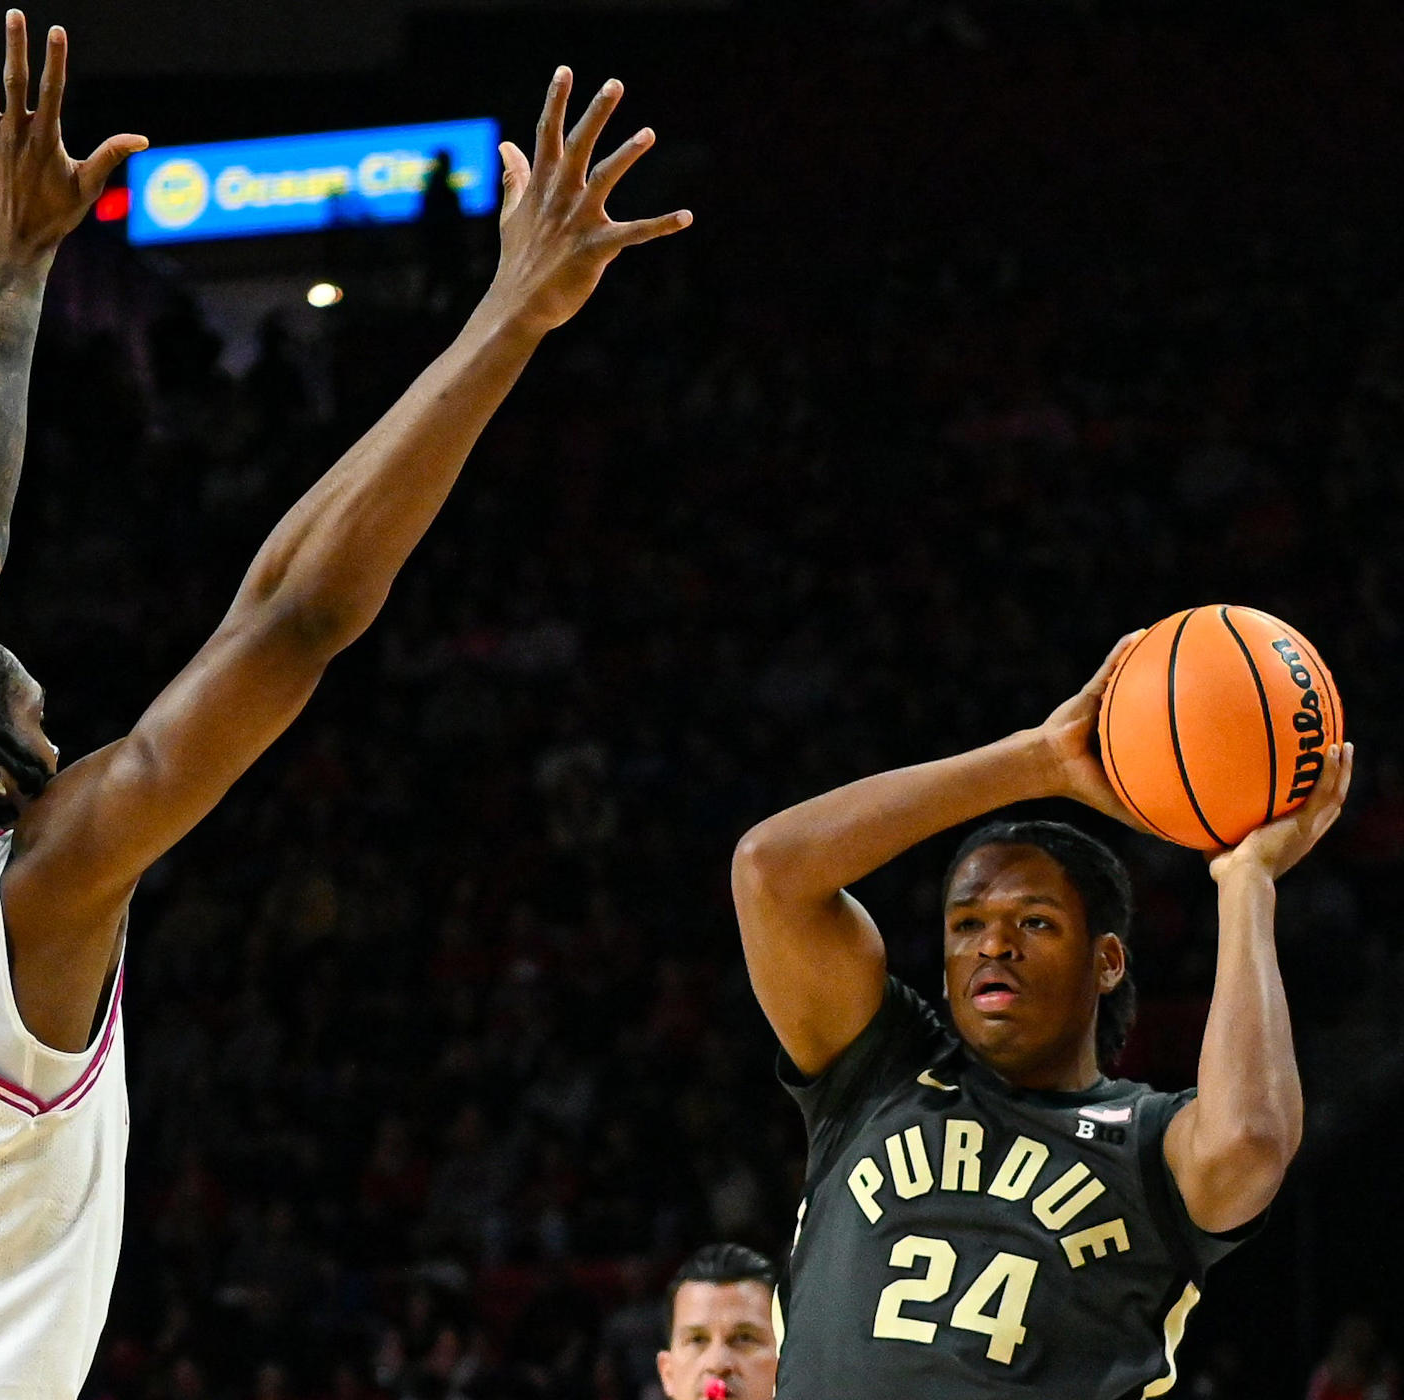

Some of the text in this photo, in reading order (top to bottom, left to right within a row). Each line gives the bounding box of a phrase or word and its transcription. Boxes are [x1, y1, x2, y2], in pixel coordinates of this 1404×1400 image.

[1271, 637, 1325, 804] Wilson
[847, 1118, 1130, 1269] PURDUE
[873, 1235, 1039, 1365] 24
